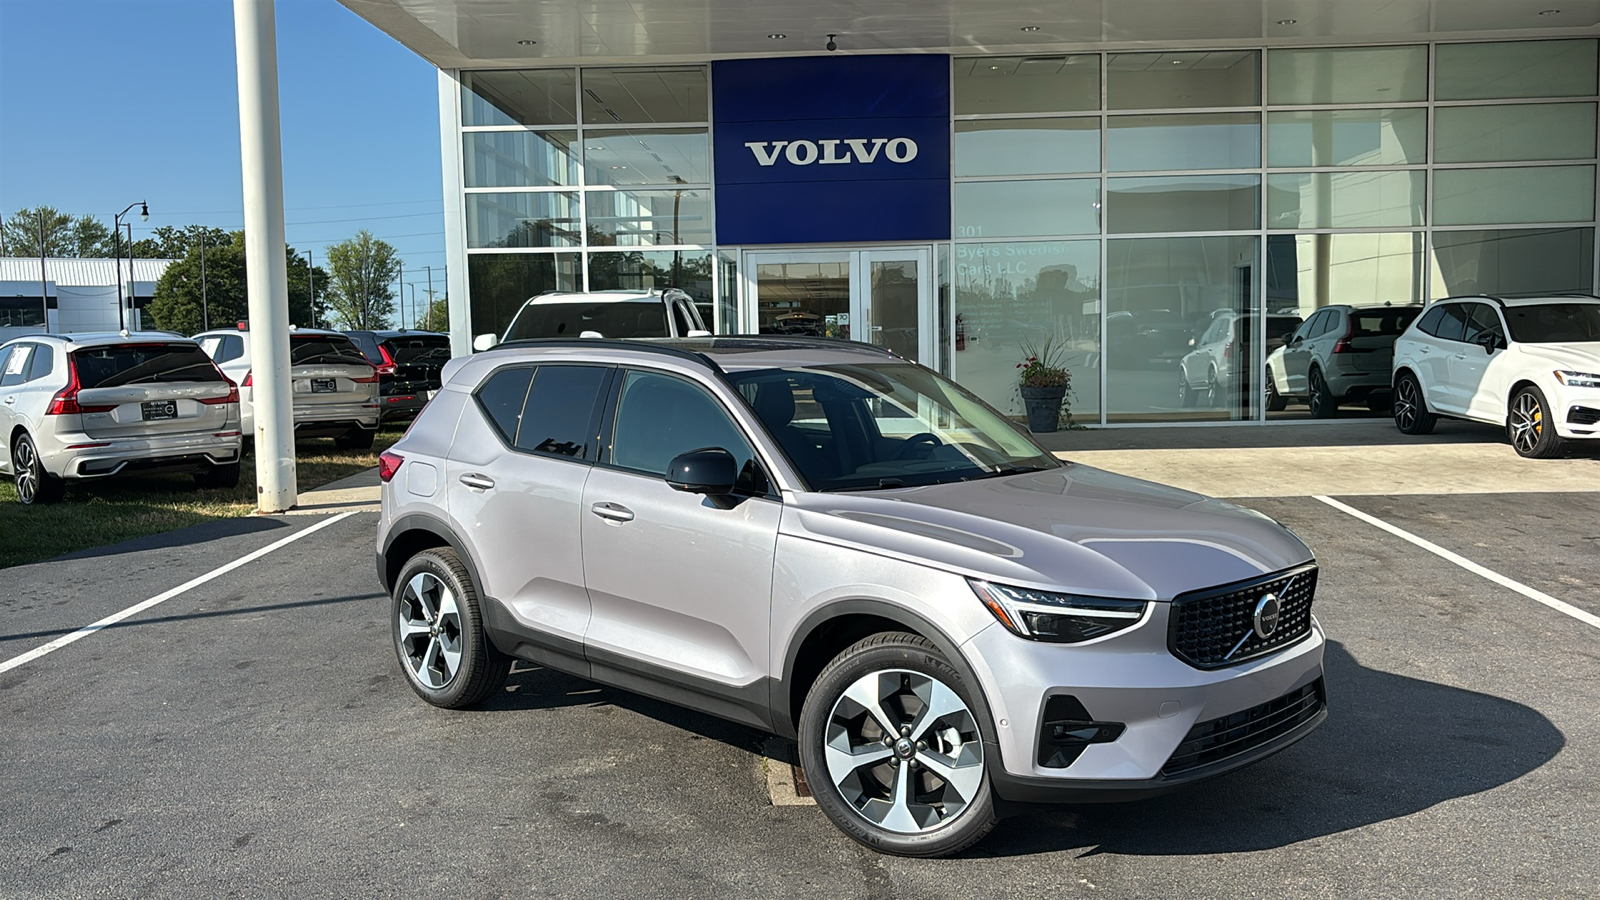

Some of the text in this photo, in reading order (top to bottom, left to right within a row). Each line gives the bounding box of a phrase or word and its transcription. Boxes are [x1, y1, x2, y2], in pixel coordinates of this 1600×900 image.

[744, 137, 918, 166] VOLVO
[957, 225, 983, 238] 301
[957, 245, 1000, 261] Byers
[957, 261, 1027, 276] Cars LLC
